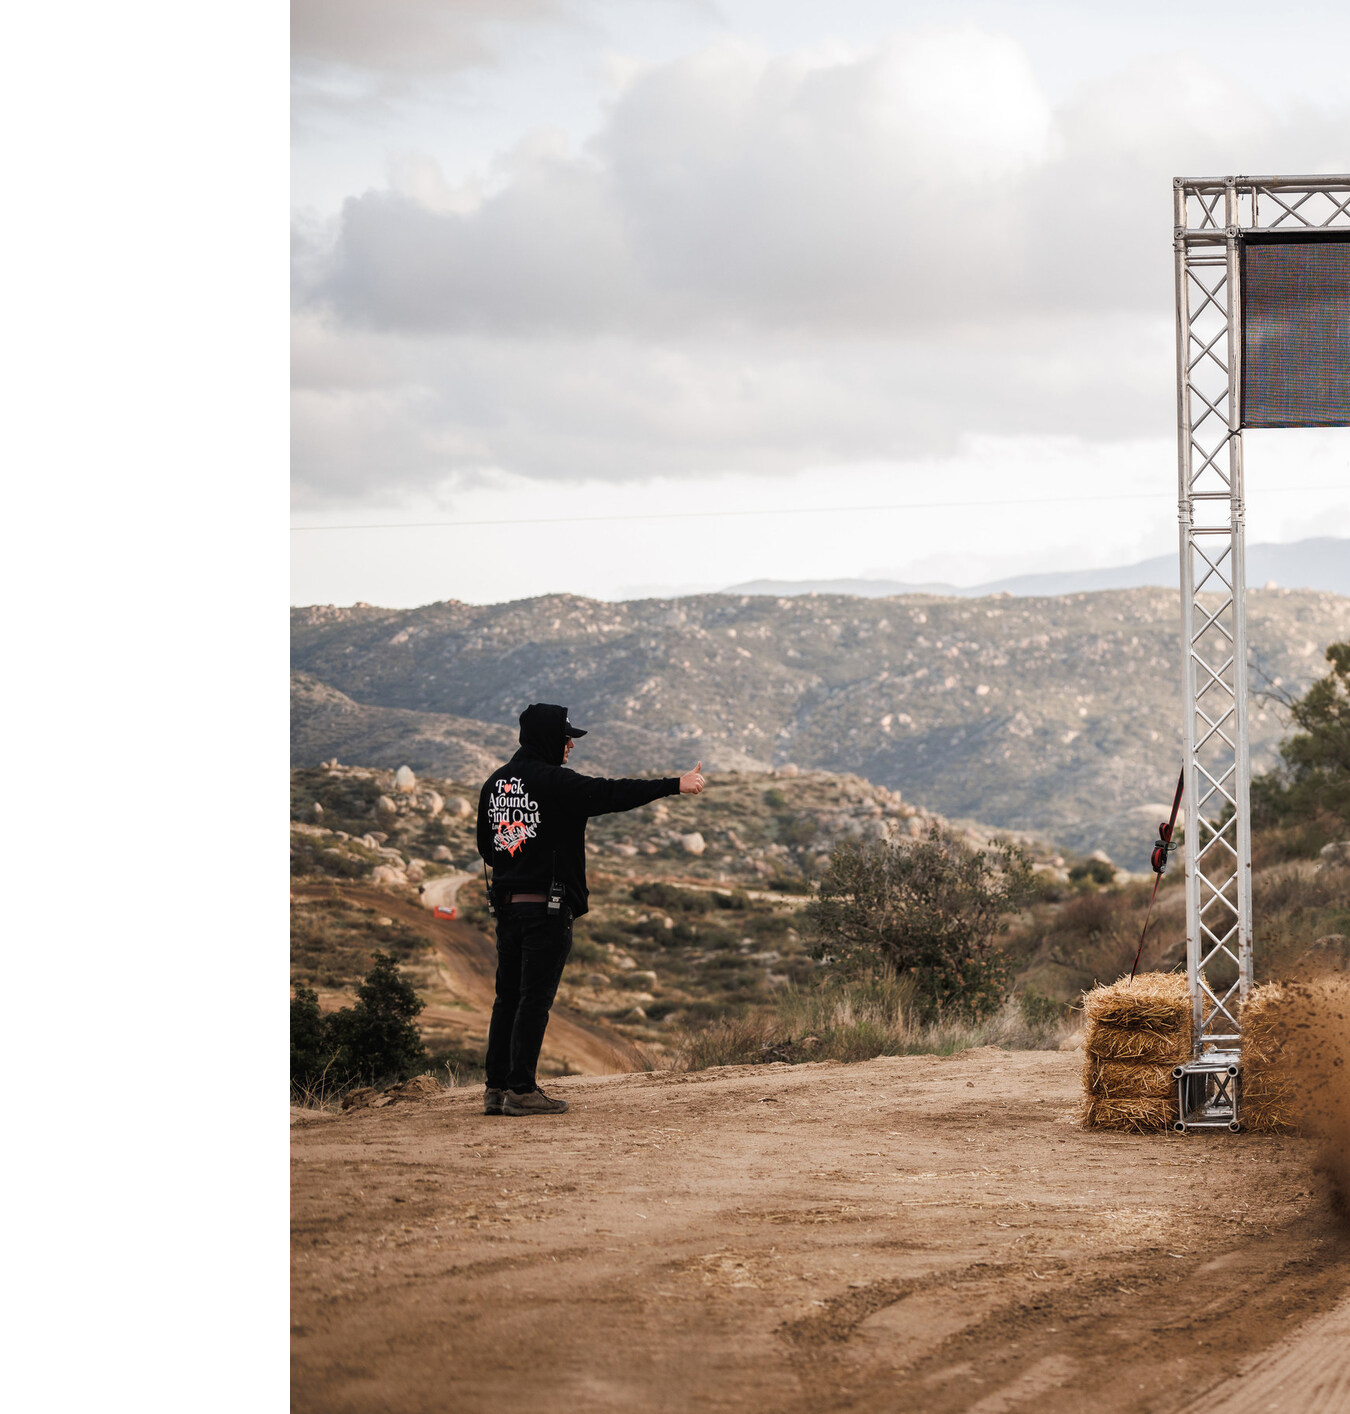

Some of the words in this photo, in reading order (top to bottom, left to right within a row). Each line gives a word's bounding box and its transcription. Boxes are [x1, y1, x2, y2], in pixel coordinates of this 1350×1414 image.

[495, 777, 525, 794] Fck
[489, 793, 538, 811] Around
[513, 809, 541, 823] Out
